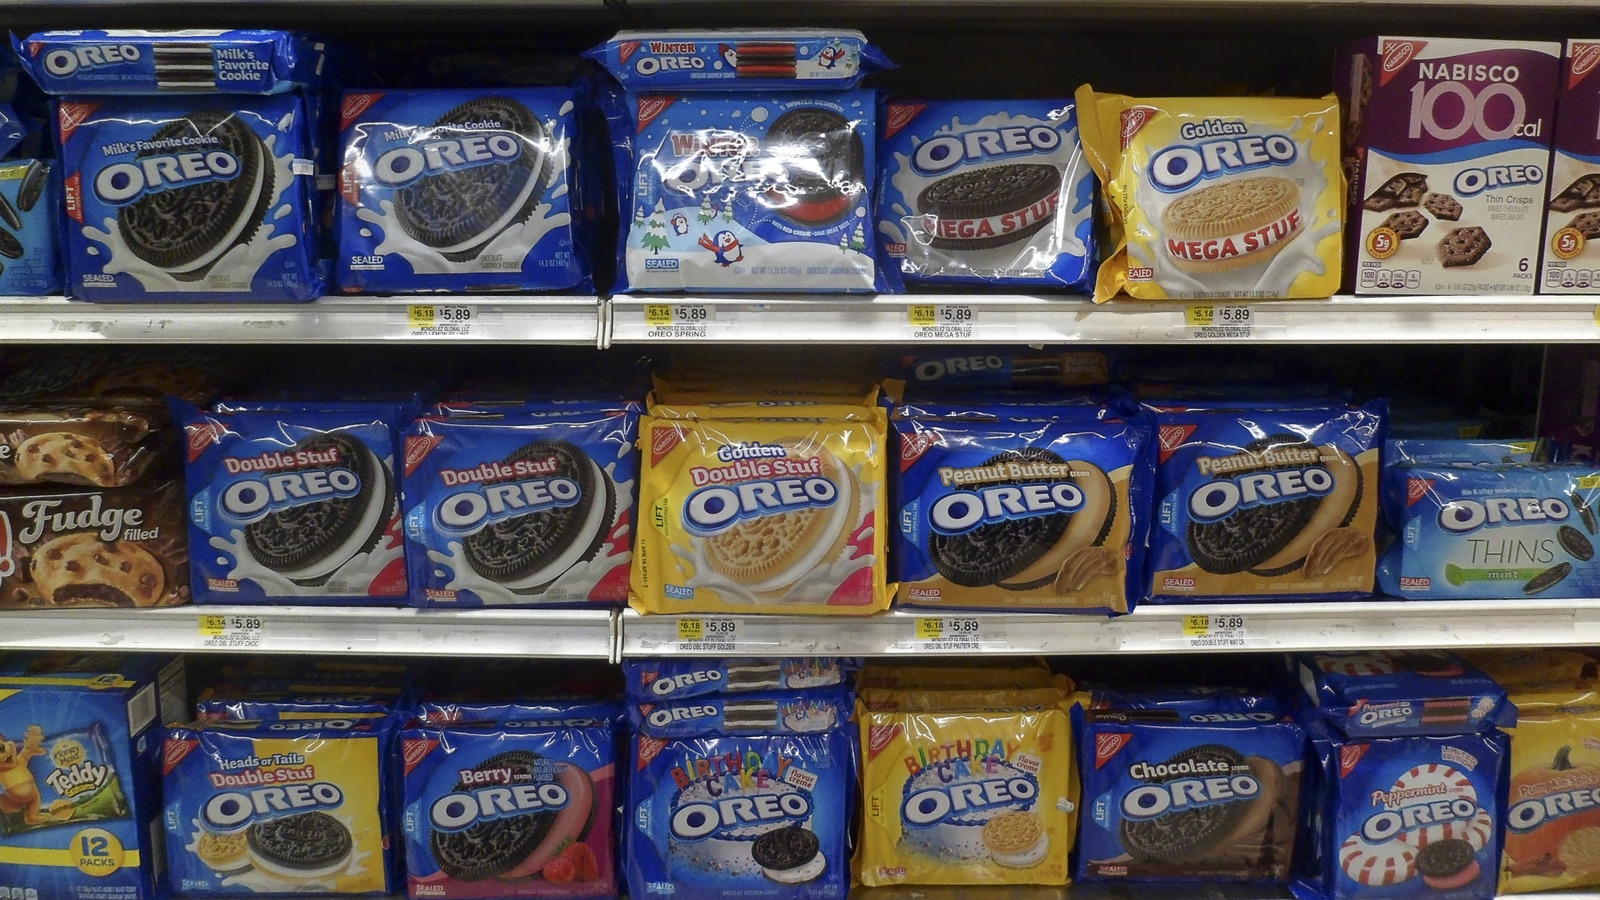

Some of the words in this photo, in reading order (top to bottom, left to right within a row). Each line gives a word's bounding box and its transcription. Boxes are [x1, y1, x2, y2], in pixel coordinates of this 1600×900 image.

[46, 44, 140, 75] OREO
[217, 49, 254, 60] Milk's
[218, 60, 269, 71] Favorite
[1385, 44, 1412, 70] NABISCO
[219, 70, 261, 81] Cookie
[636, 57, 705, 75] OREO
[1419, 63, 1519, 82] NABISCO
[344, 96, 370, 118] NABISCO
[640, 97, 665, 119] NABISCO
[786, 99, 814, 109] WINTER
[1409, 81, 1526, 141] 100
[1513, 118, 1542, 137] cal
[62, 105, 86, 130] NABISCO
[464, 119, 501, 131] Cookie
[889, 106, 914, 128] NABISCO
[1182, 120, 1246, 139] Golden
[102, 143, 136, 156] Milk's
[136, 137, 182, 150] Favorite
[182, 134, 218, 146] Cookie
[915, 126, 1059, 171] OREO
[376, 135, 518, 184] OREO
[1153, 137, 1294, 186] OREO
[97, 152, 238, 201] OREO
[1456, 165, 1543, 194] OREO
[67, 185, 76, 211] LIFT
[1486, 194, 1504, 203] Thin
[1506, 194, 1533, 205] Crisps
[923, 217, 995, 239] MEGA
[1001, 191, 1060, 234] STUF
[1168, 238, 1239, 261] MEGA
[1243, 208, 1300, 253] STUF
[352, 256, 383, 265] SEALED
[647, 259, 678, 269] SEALED
[1518, 258, 1529, 272] 6
[83, 274, 114, 283] SEALED
[439, 309, 470, 320] $5.89
[675, 308, 707, 320] $5.89
[940, 308, 972, 320] $5.89
[1219, 309, 1250, 320] $5.89
[915, 355, 1003, 381] OREO
[655, 431, 677, 453] NABISCO
[719, 442, 785, 461] Golden
[225, 452, 294, 474] Double
[297, 449, 337, 466] Stuf
[441, 463, 512, 485] Double
[516, 458, 557, 474] Stuf
[691, 461, 772, 486] Double
[774, 459, 820, 475] Stuf
[1200, 455, 1258, 474] Peanut
[1264, 450, 1318, 465] Butter
[941, 462, 1007, 485] Peanut
[1010, 461, 1068, 479] Butter
[1069, 470, 1091, 478] creme
[224, 471, 358, 514] OREO
[440, 479, 578, 526] OREO
[688, 478, 836, 524] OREO
[1191, 468, 1332, 517] OREO
[195, 500, 204, 523] LIFT
[656, 504, 664, 528] LIFT
[932, 484, 1082, 530] OREO
[1162, 501, 1171, 524] LIFT
[1441, 498, 1569, 531] OREO
[19, 496, 143, 544] Fudge
[411, 514, 419, 537] LIFT
[903, 509, 912, 533] LIFT
[124, 527, 160, 541] filled
[1406, 526, 1414, 544] LIFT
[1467, 539, 1555, 564] THINS
[208, 579, 237, 588] SEALED
[1164, 578, 1194, 587] SEALED
[1400, 578, 1430, 587] SEALED
[1488, 570, 1519, 579] mint
[426, 589, 455, 598] SEALED
[665, 585, 693, 597] SEALED
[910, 588, 940, 597] SEALED
[231, 618, 261, 629] $5.89
[706, 621, 736, 632] $5.89
[949, 621, 979, 631] $5.89
[1214, 617, 1243, 628] $5.89
[652, 669, 722, 695] OREO
[649, 705, 718, 728] OREO
[1190, 712, 1275, 722] OREO
[1360, 707, 1412, 724] OREO
[405, 742, 427, 763] NABISCO
[1099, 735, 1120, 757] NABISCO
[219, 755, 260, 771] Heads
[261, 758, 273, 766] or
[274, 753, 305, 766] Tails
[904, 738, 1021, 777] BIRTHDAY
[1016, 762, 1038, 773] creme
[1018, 755, 1040, 768] flavor
[46, 762, 106, 794] Teddy
[211, 770, 274, 787] Double
[277, 767, 315, 781] Stuf
[460, 767, 512, 785] Berry
[671, 751, 793, 790] BIRTHDAY
[790, 769, 814, 783] flavor
[937, 756, 999, 783] CAKE
[1130, 759, 1229, 779] Chocolate
[706, 768, 770, 797] CAKE
[788, 776, 812, 788] creme
[1519, 777, 1567, 797] Pumpkin
[206, 783, 341, 825] OREO
[905, 778, 1035, 823] OREO
[1124, 776, 1258, 817] OREO
[1371, 782, 1447, 806] Peppermint
[432, 784, 567, 828] OREO
[672, 794, 808, 837] OREO
[872, 796, 880, 817] LIFT
[1096, 801, 1105, 821] LIFT
[168, 811, 177, 830] LIFT
[407, 811, 415, 832] LIFT
[640, 806, 648, 830] LIFT
[1364, 800, 1475, 840] OREO
[82, 836, 109, 857] 12
[80, 858, 115, 867] PACKS
